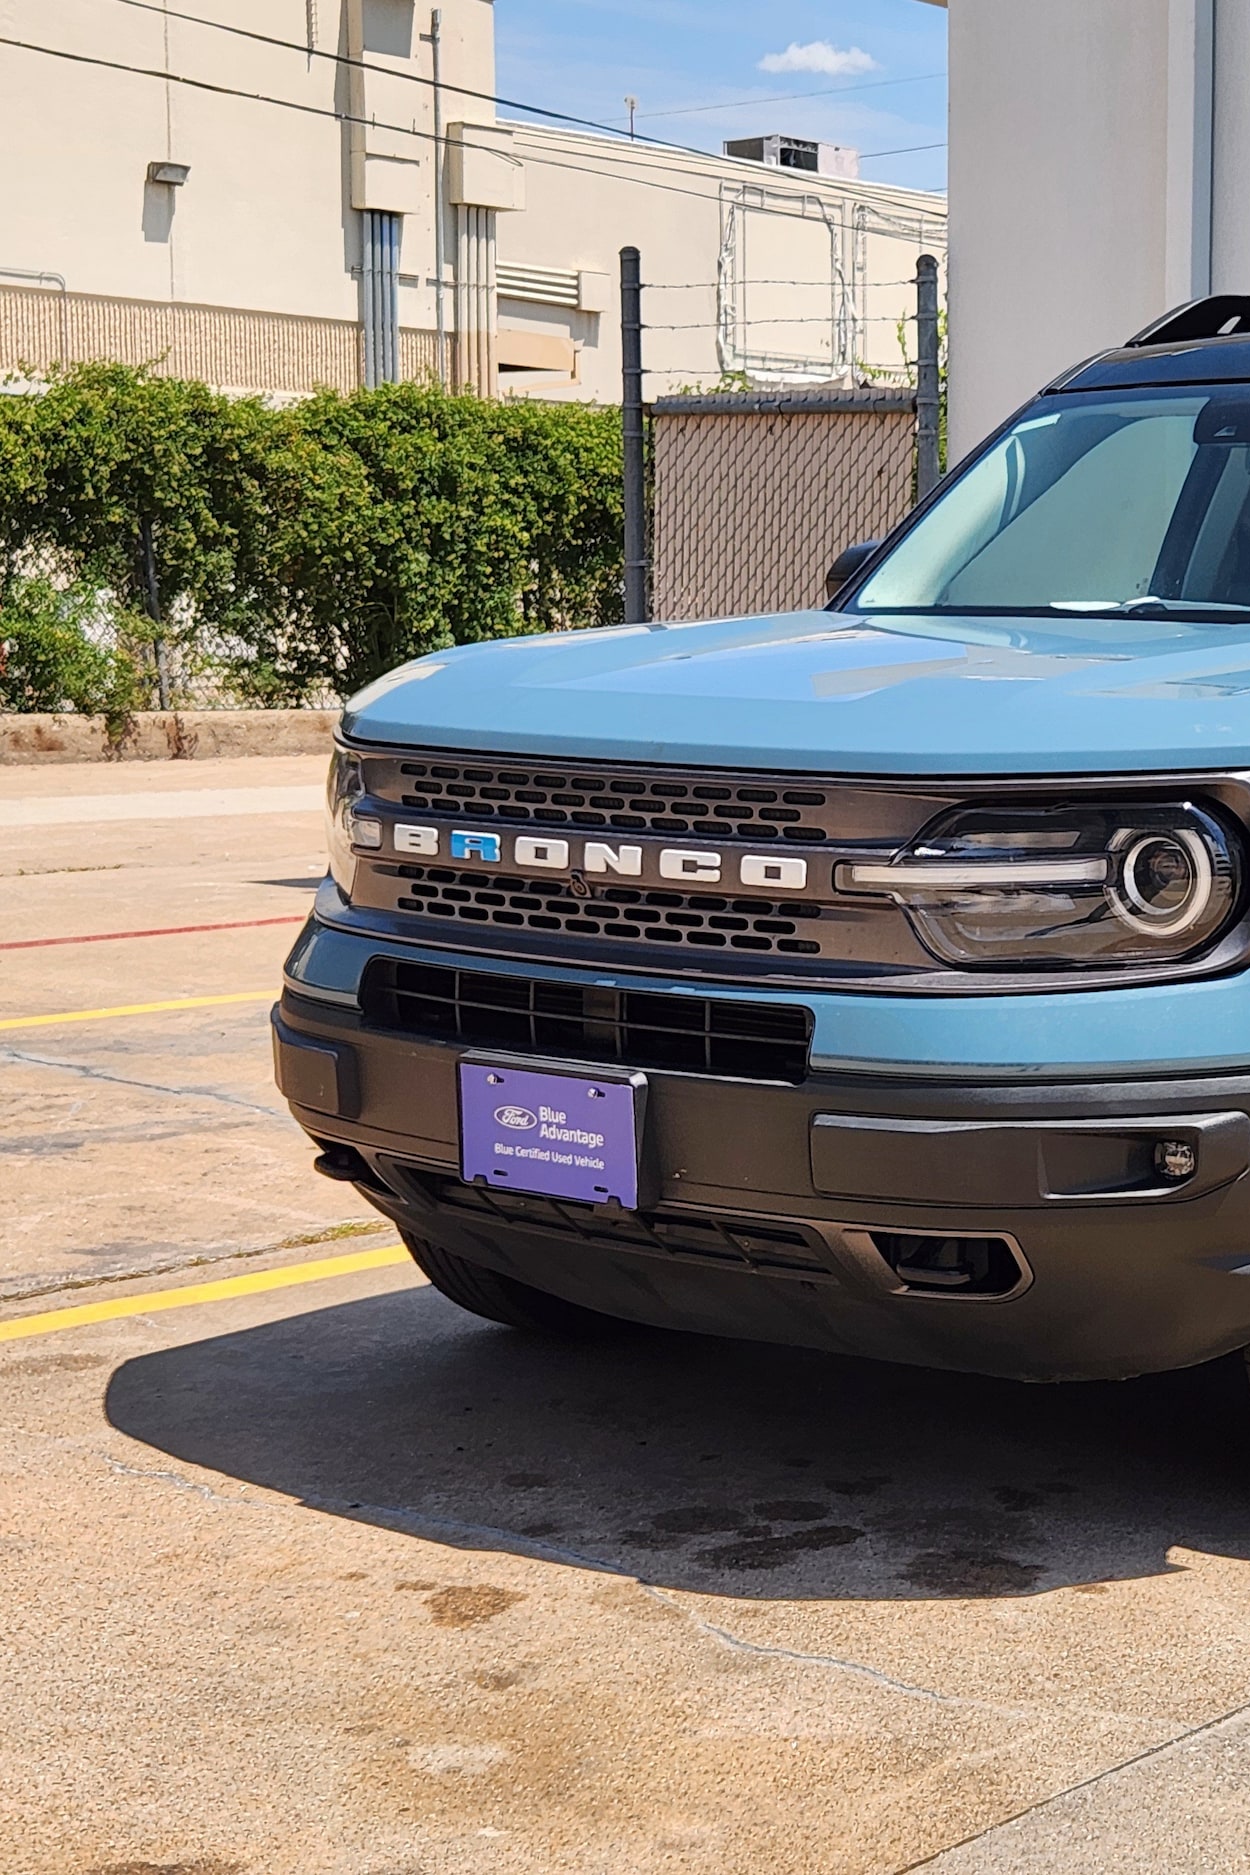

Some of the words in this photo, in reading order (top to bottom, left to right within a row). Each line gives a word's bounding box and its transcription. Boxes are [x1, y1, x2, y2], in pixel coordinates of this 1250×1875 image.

[393, 822, 808, 890] BRONCO
[501, 1107, 529, 1126] Ford
[539, 1106, 567, 1124] Blue
[539, 1123, 604, 1148] Advantage
[494, 1142, 514, 1155] Blue
[515, 1145, 550, 1161] Certified
[551, 1151, 573, 1165] Used
[574, 1155, 605, 1170] Vehicle
